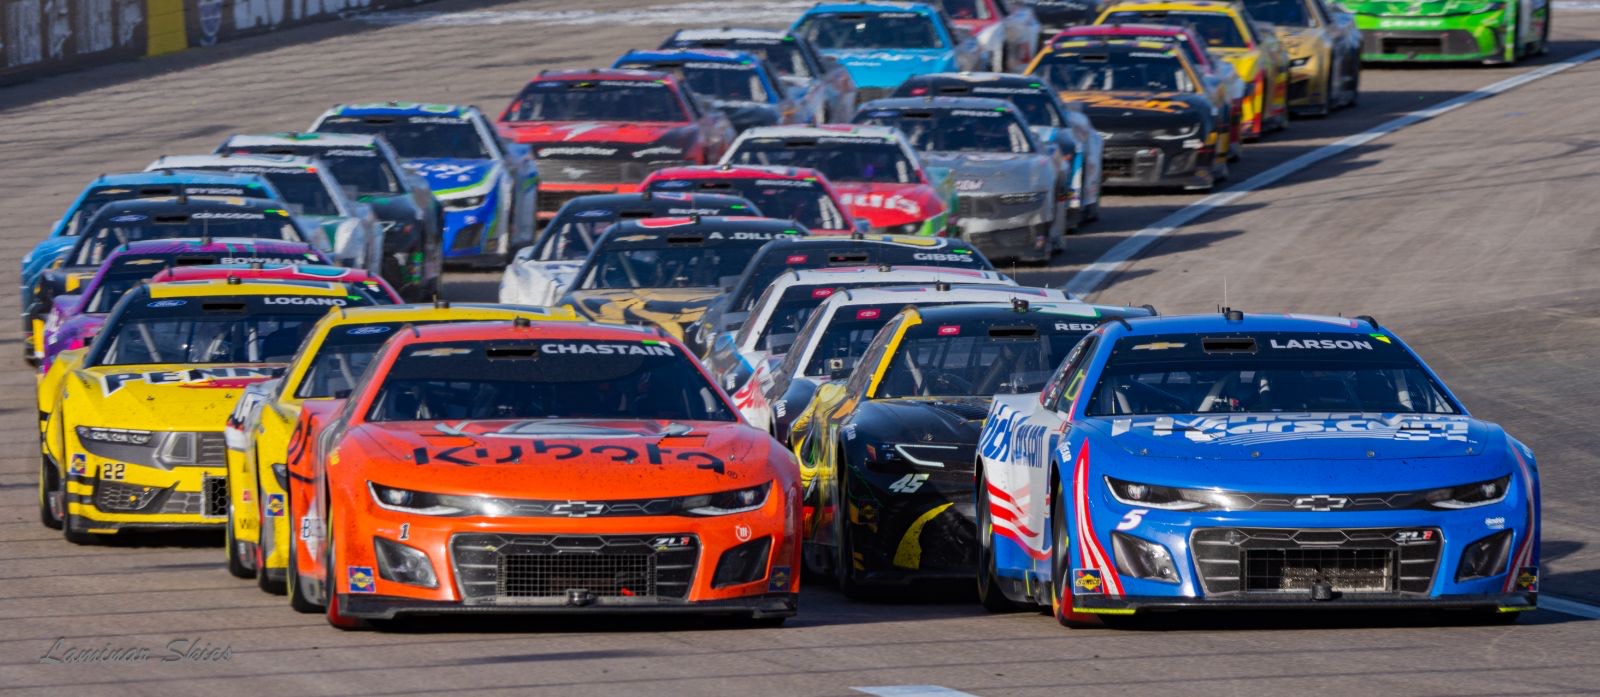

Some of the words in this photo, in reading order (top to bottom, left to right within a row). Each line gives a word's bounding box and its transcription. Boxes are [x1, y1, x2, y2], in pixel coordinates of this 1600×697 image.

[708, 231, 724, 240] A
[220, 256, 308, 266] BOWMAN
[913, 252, 974, 262] GIBBS
[263, 297, 347, 307] LOGANO
[1055, 322, 1098, 331] RED
[541, 342, 675, 358] CHASTAIN
[1270, 338, 1373, 351] LARSON
[103, 463, 126, 480] 22
[888, 473, 930, 494] 45
[1116, 509, 1148, 531] 5
[400, 523, 410, 540] 1
